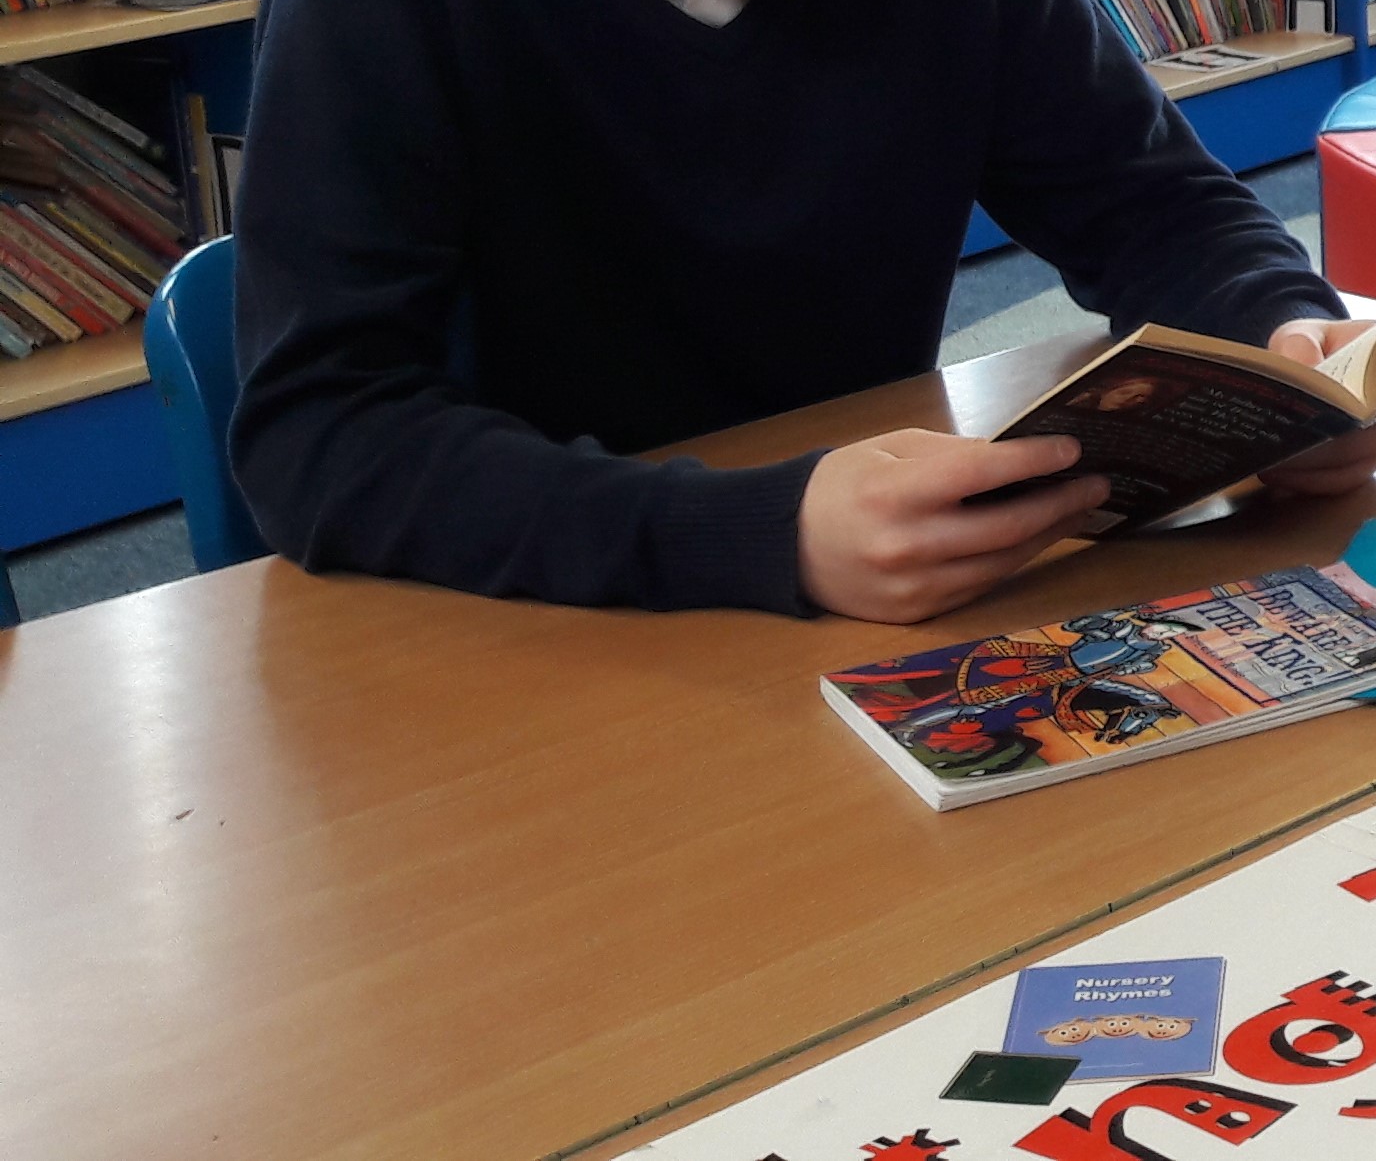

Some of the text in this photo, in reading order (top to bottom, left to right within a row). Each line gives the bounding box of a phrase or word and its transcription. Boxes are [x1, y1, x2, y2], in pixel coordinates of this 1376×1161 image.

[1198, 600, 1261, 637] THE
[1074, 973, 1176, 989] Nursery
[1073, 988, 1173, 1003] Rhymes
